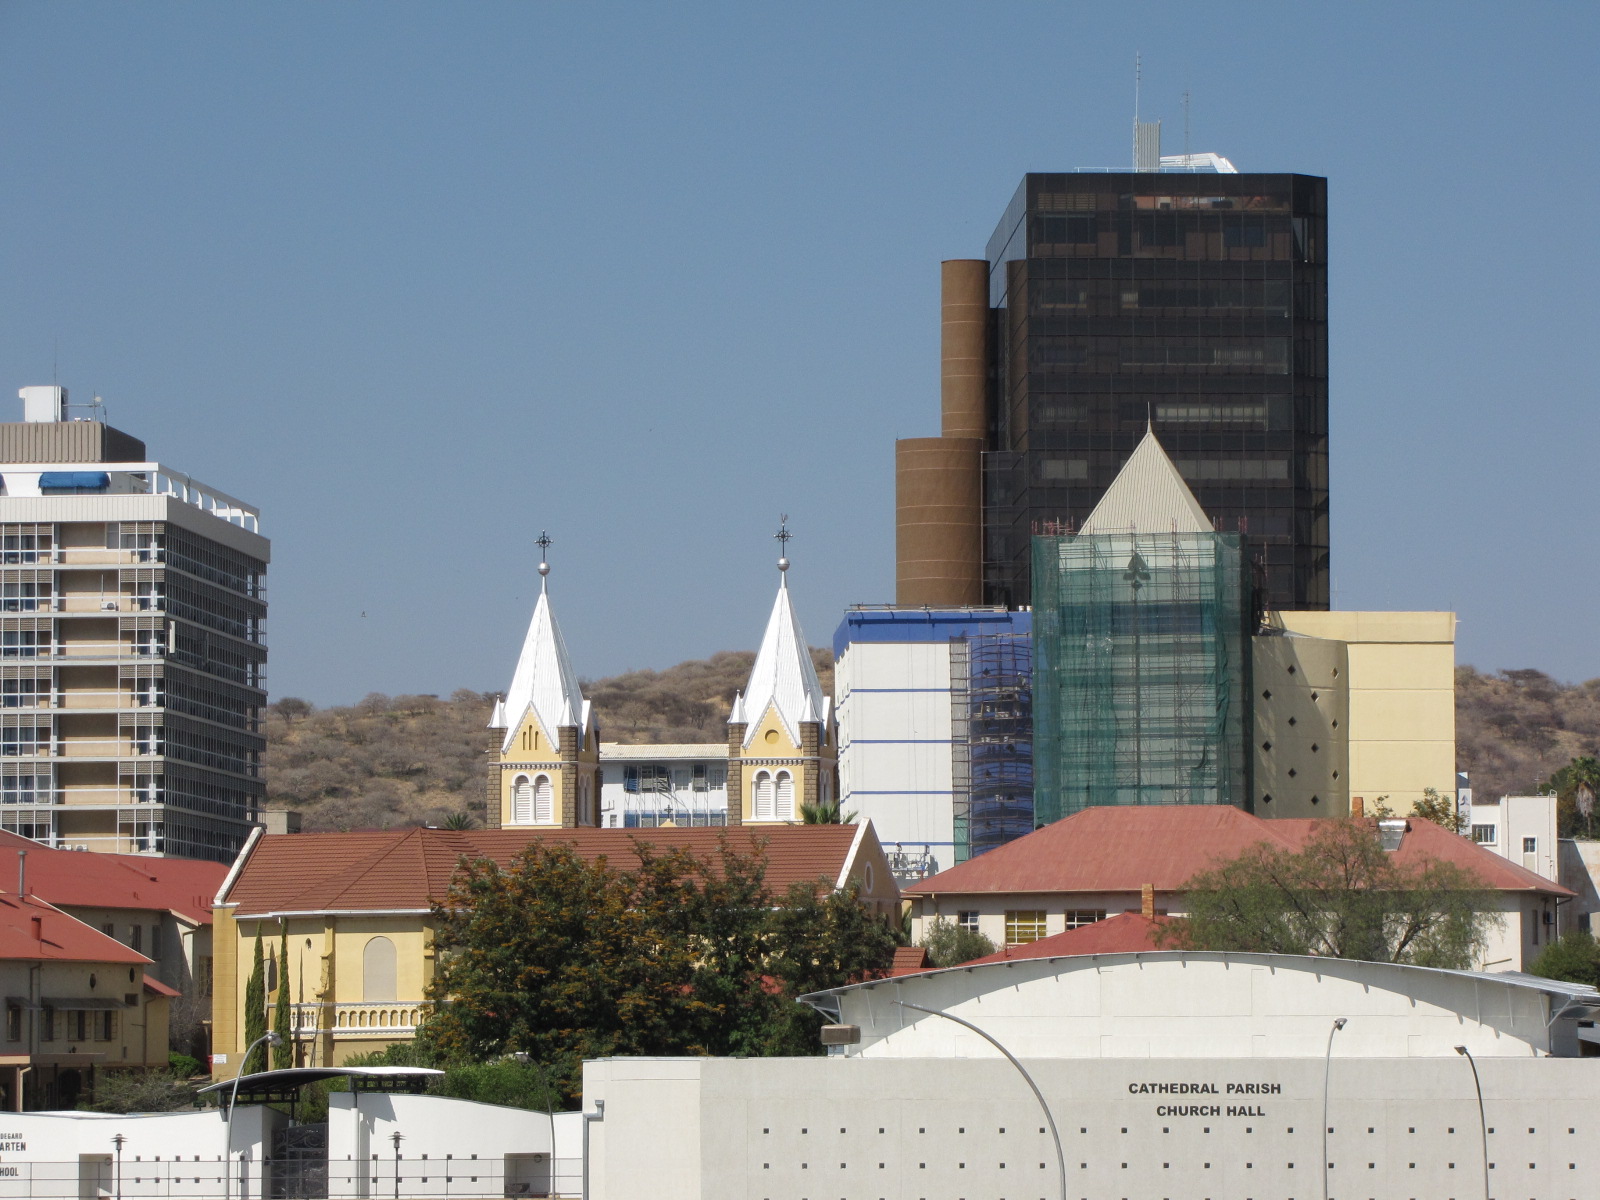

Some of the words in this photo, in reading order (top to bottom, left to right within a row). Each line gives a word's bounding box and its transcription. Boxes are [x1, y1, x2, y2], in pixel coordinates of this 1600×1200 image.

[1128, 1083, 1220, 1094] CATHEDRAL
[1226, 1083, 1282, 1094] PARISH
[1156, 1105, 1221, 1117] CHURCH
[1226, 1105, 1266, 1117] HALL
